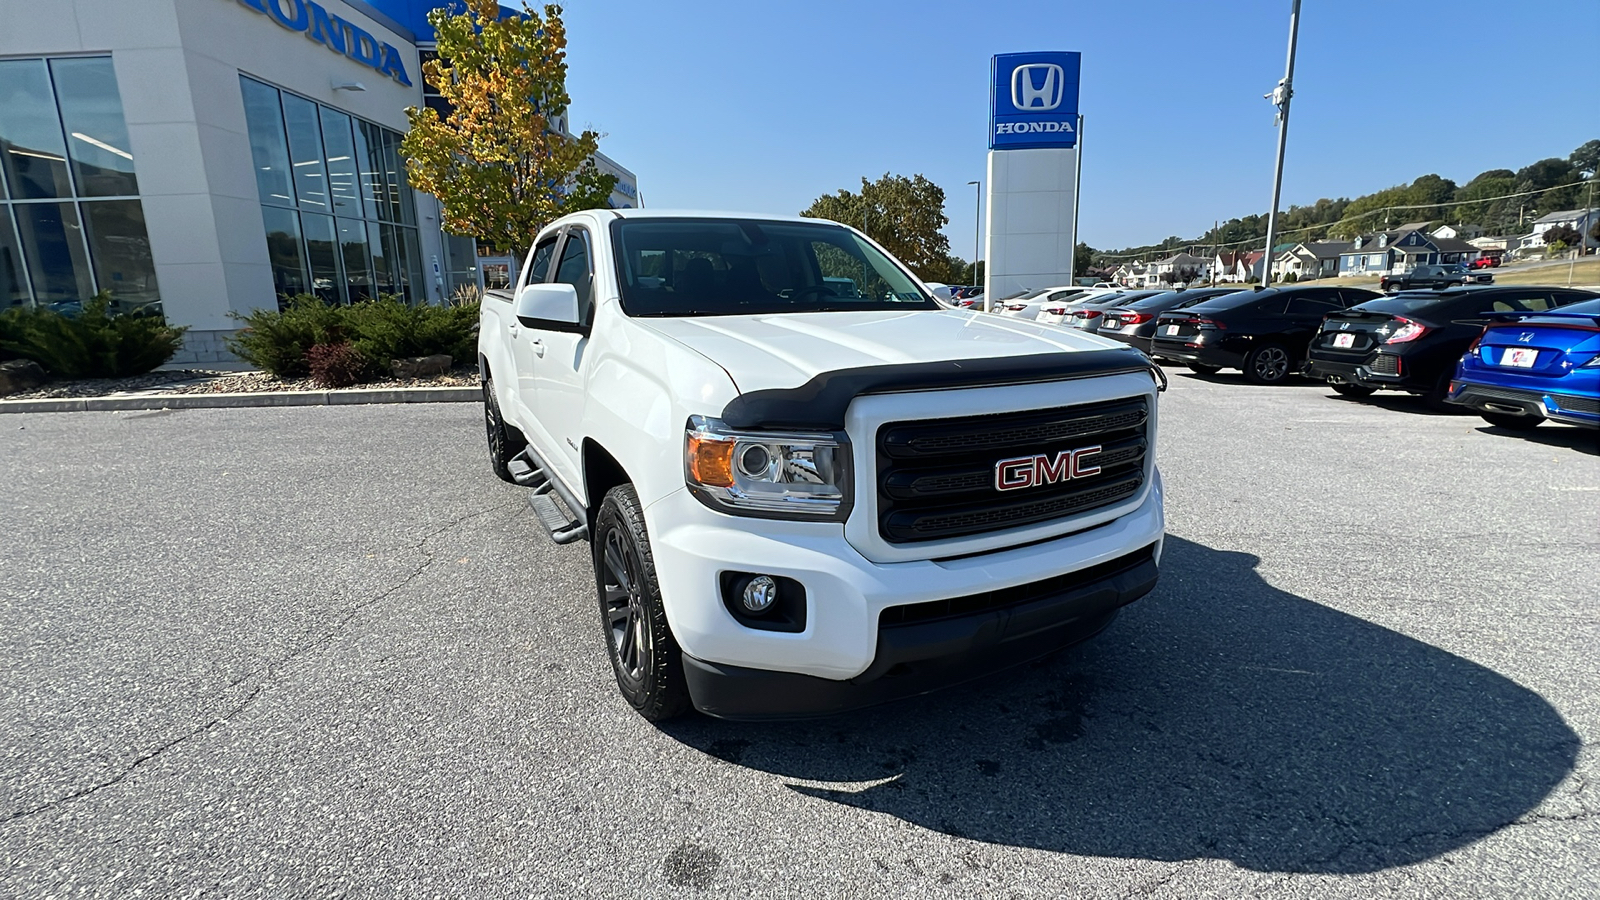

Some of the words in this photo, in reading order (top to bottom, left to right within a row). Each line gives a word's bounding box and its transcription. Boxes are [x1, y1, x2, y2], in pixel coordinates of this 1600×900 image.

[233, 0, 412, 87] ONDA
[996, 122, 1074, 134] HONDA
[995, 444, 1102, 491] GMC
